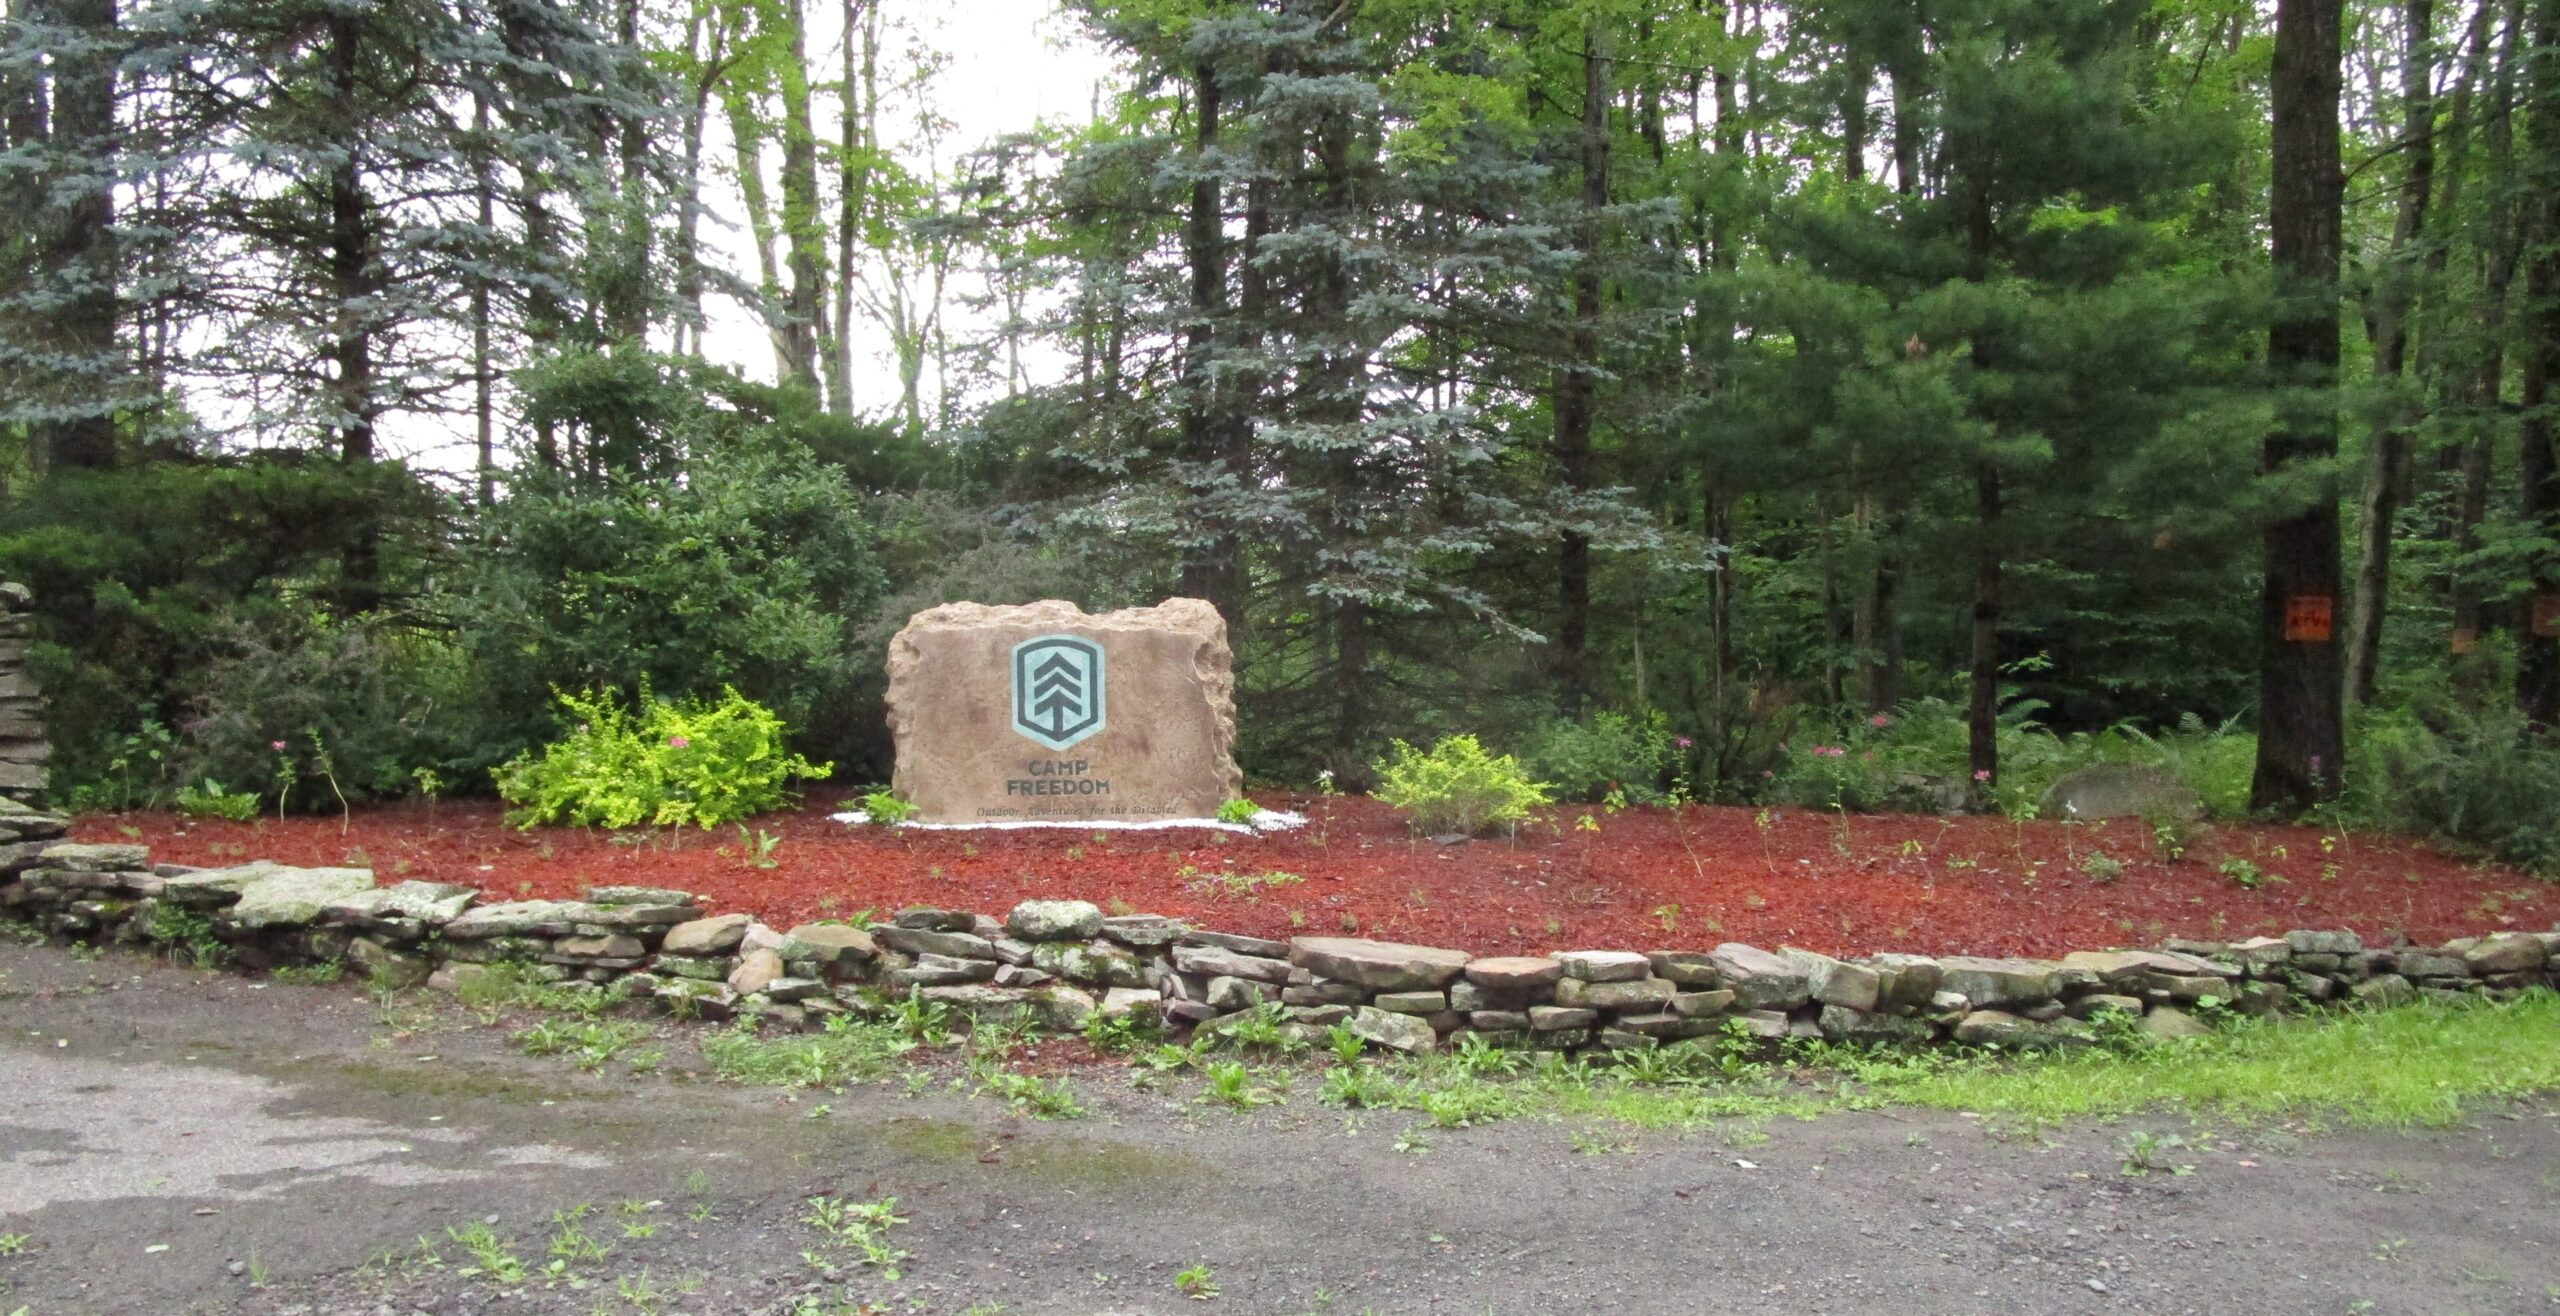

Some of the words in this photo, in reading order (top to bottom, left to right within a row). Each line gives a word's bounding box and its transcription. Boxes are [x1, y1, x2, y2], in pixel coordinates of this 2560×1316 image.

[1028, 759, 1089, 776] CAMP
[1007, 779, 1111, 796] FREEDOM
[976, 807, 1020, 817] Outdoor
[1088, 803, 1107, 818] for
[1111, 804, 1128, 815] the
[1131, 803, 1179, 816] Disabled
